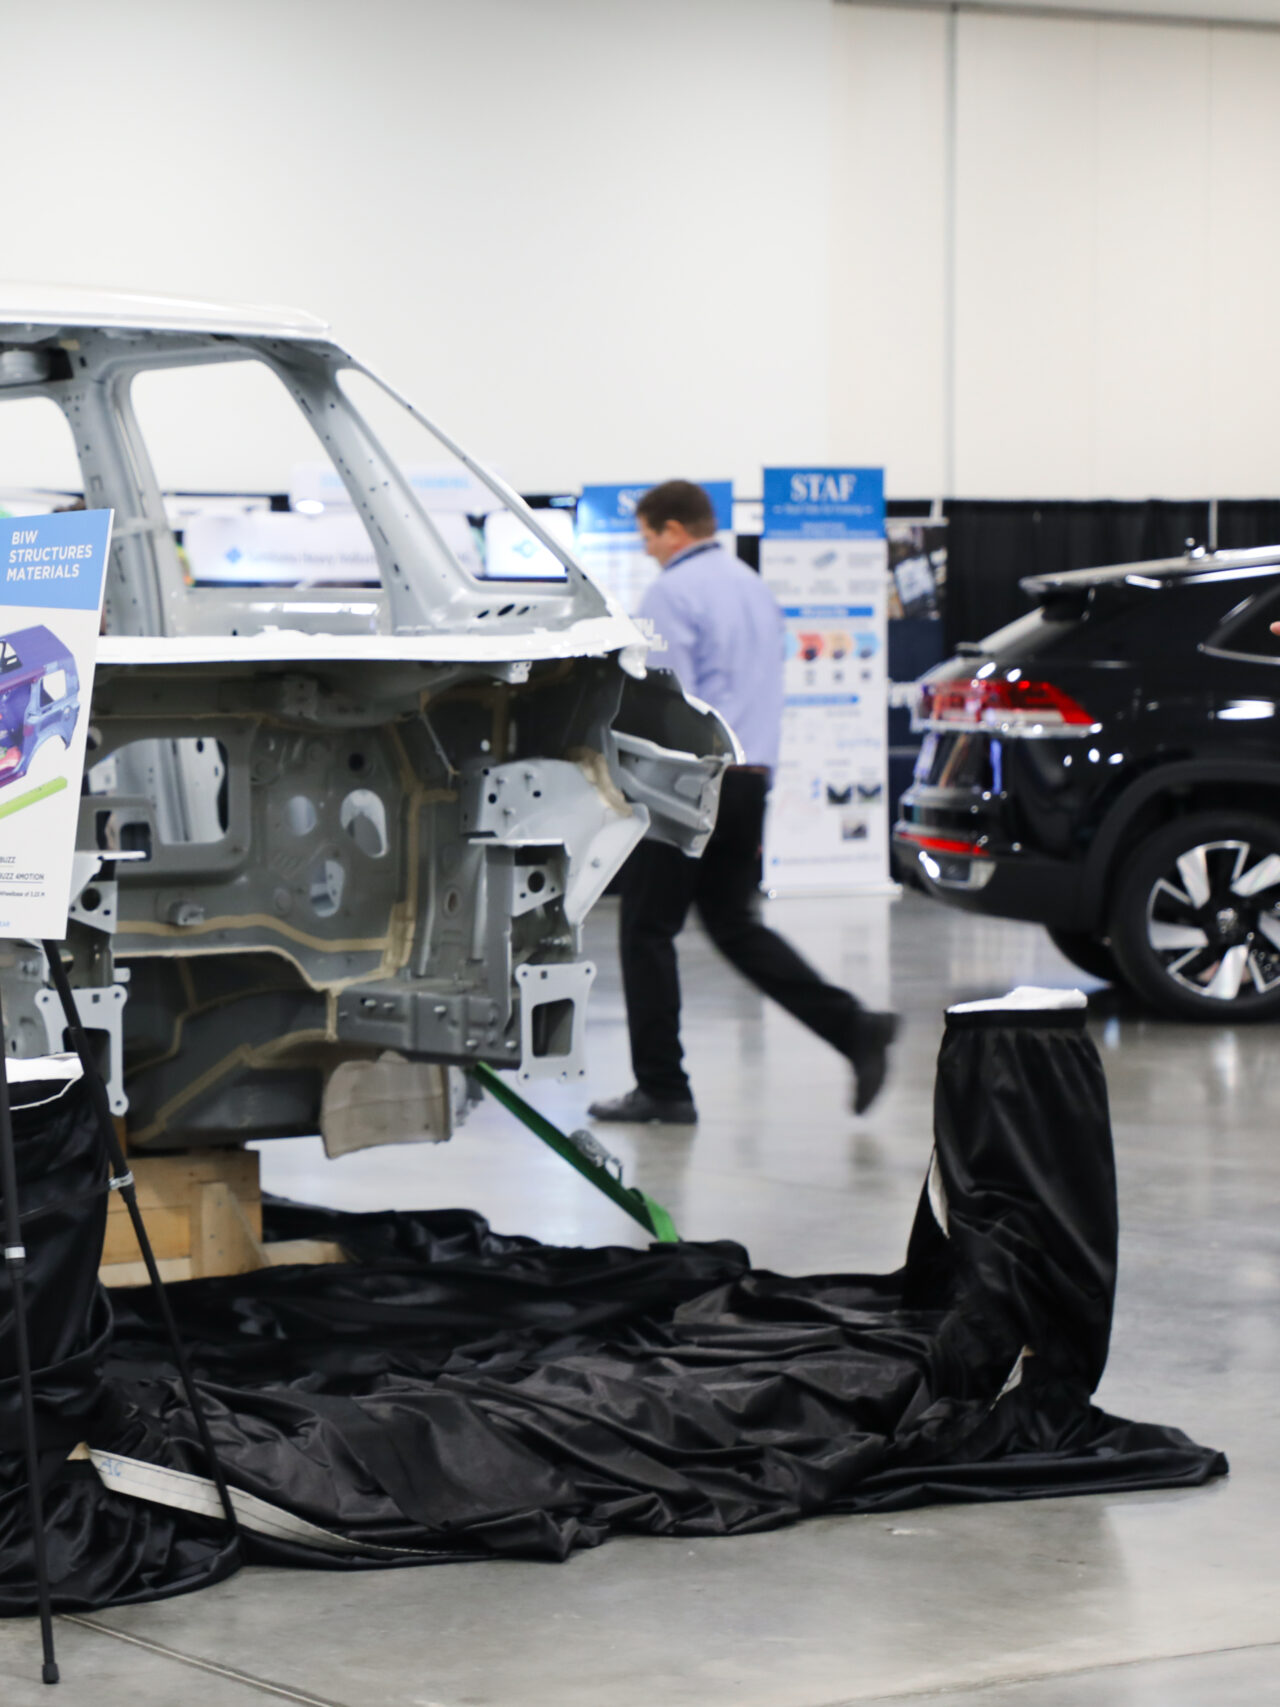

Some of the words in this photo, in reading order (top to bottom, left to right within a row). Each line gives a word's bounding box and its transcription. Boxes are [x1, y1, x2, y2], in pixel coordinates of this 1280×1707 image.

[790, 472, 856, 502] STAF
[11, 530, 39, 545] BIW
[9, 544, 94, 563] STRUCTURES
[6, 564, 81, 582] MATERIALS
